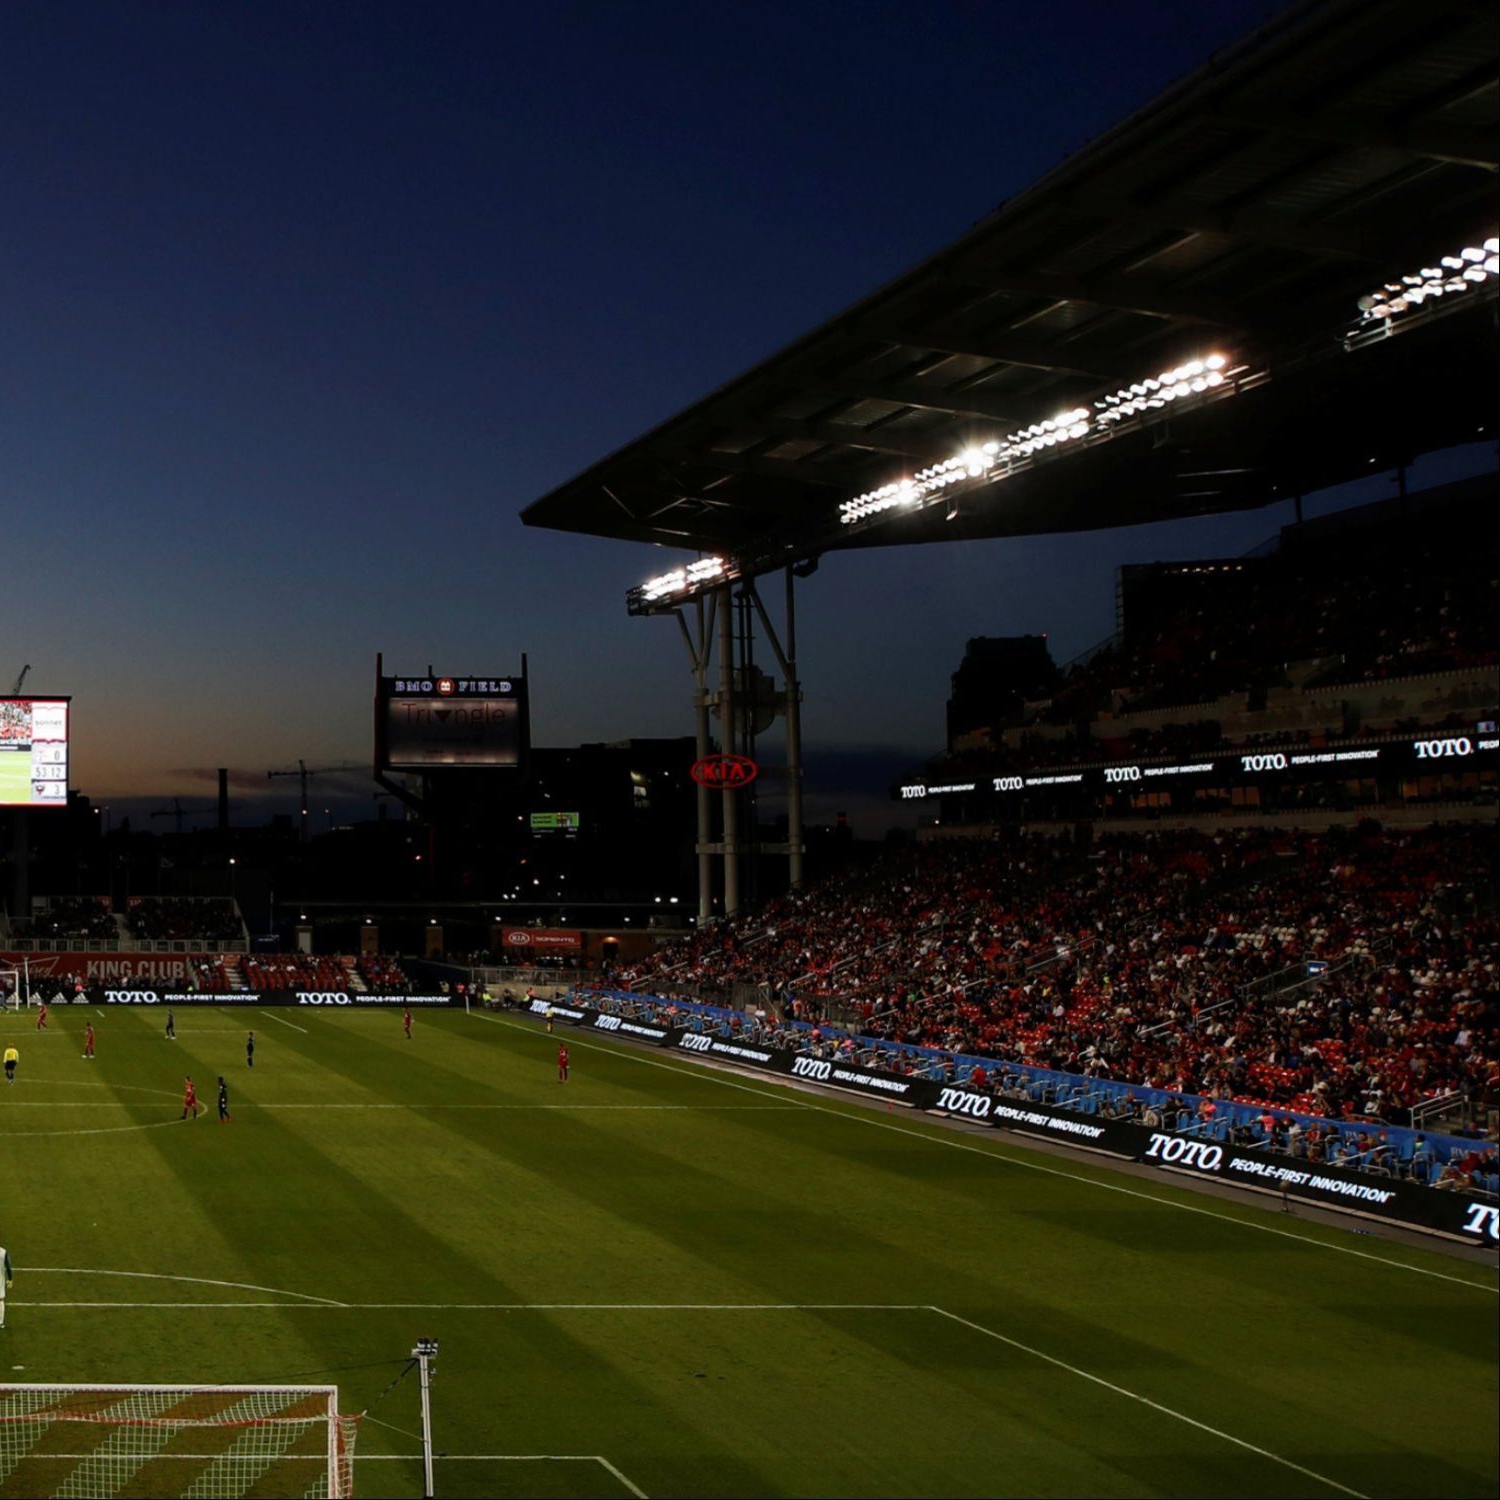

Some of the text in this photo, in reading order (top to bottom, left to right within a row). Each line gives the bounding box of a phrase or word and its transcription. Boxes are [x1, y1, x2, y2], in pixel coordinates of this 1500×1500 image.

[395, 681, 512, 692] BMO FIELD
[1414, 737, 1474, 759] TOTO
[703, 762, 746, 780] KIA
[1241, 753, 1288, 772] TOTO
[1104, 766, 1142, 783] TOTO
[993, 776, 1024, 791] TOTO
[87, 961, 185, 978] KING CLUB
[104, 990, 160, 1003] TOTO
[296, 992, 351, 1005] TOTO
[791, 1056, 832, 1080] TOTO
[936, 1088, 1105, 1138] TOTO PEOPLE-FIRST INNOVATION
[1146, 1133, 1395, 1204] TOTO PEOPLE-FIRST INNOVATION
